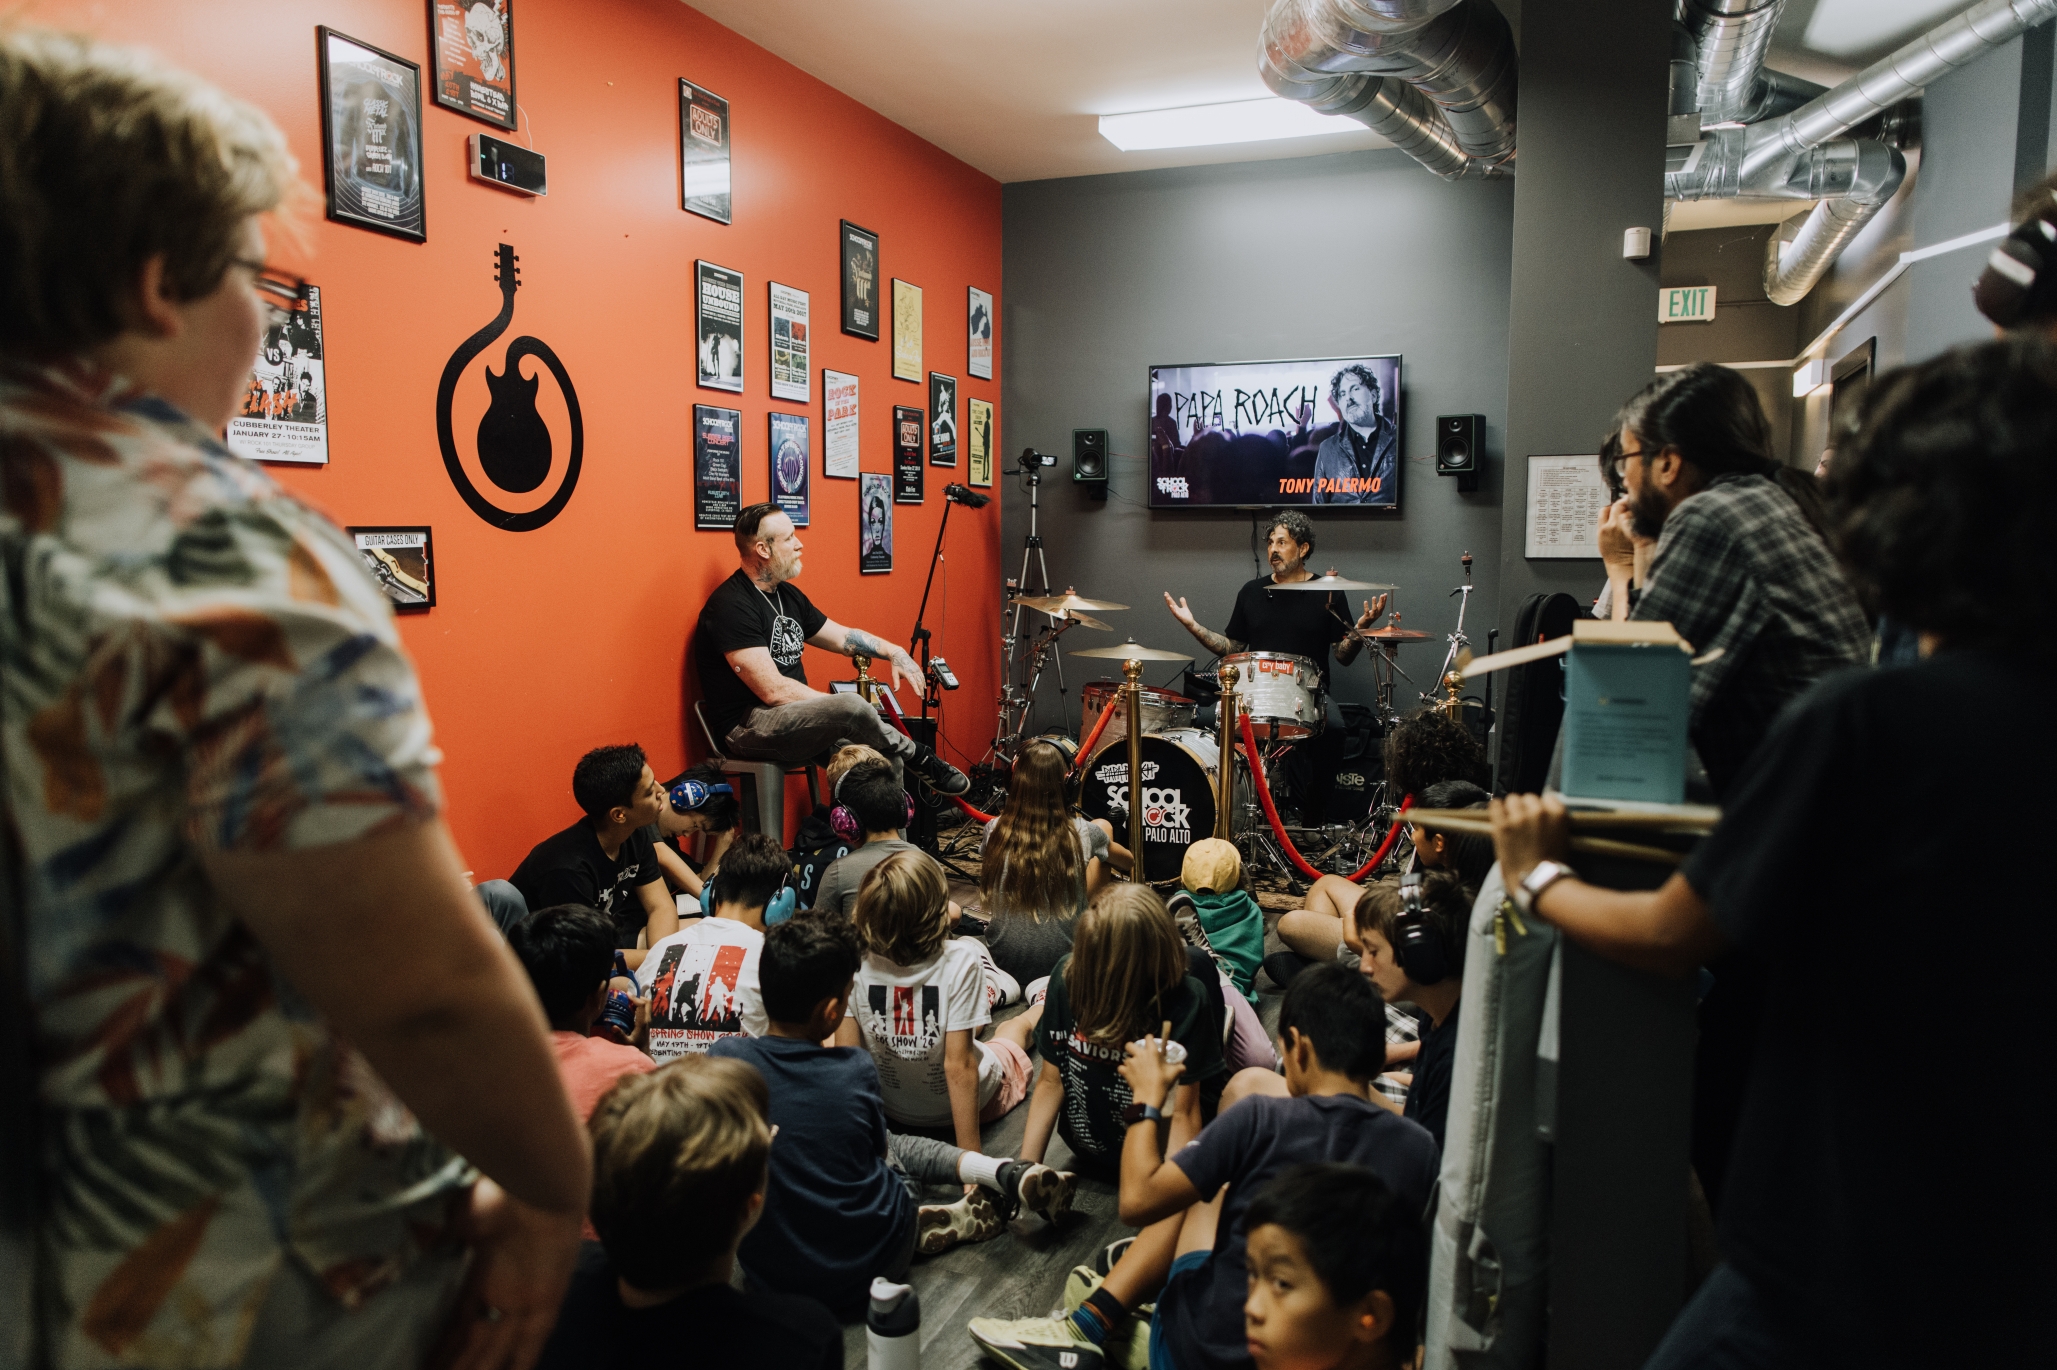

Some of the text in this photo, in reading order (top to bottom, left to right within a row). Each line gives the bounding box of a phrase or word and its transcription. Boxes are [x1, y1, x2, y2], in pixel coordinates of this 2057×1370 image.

[692, 108, 718, 129] ADULTS
[695, 122, 716, 140] ONLY
[702, 282, 740, 304] HOUSE
[702, 294, 740, 312] UNBOUND
[1669, 288, 1708, 317] EXIT
[266, 348, 280, 362] VS
[827, 384, 856, 401] ROCK
[239, 389, 298, 416] CLASH
[1174, 384, 1318, 432] PAPA ROACH
[827, 404, 857, 421] PARK
[233, 420, 320, 433] CUBBERLEY THEATER
[233, 430, 269, 438] JANUARY
[287, 434, 320, 442] 10:15AM
[903, 433, 916, 442] ONLY
[1157, 477, 1185, 486] SCHOOL
[1279, 477, 1382, 494] TONY PALERMO
[365, 534, 419, 546] GUITAR CASES ONLY
[1262, 660, 1291, 674] cry baby
[1145, 827, 1190, 844] PALO ALTO
[650, 1029, 684, 1039] SPRING
[686, 1030, 715, 1040] SHOW
[892, 1036, 917, 1048] SHOW
[920, 1036, 935, 1048] '24
[1068, 1034, 1129, 1063] SAVIORS
